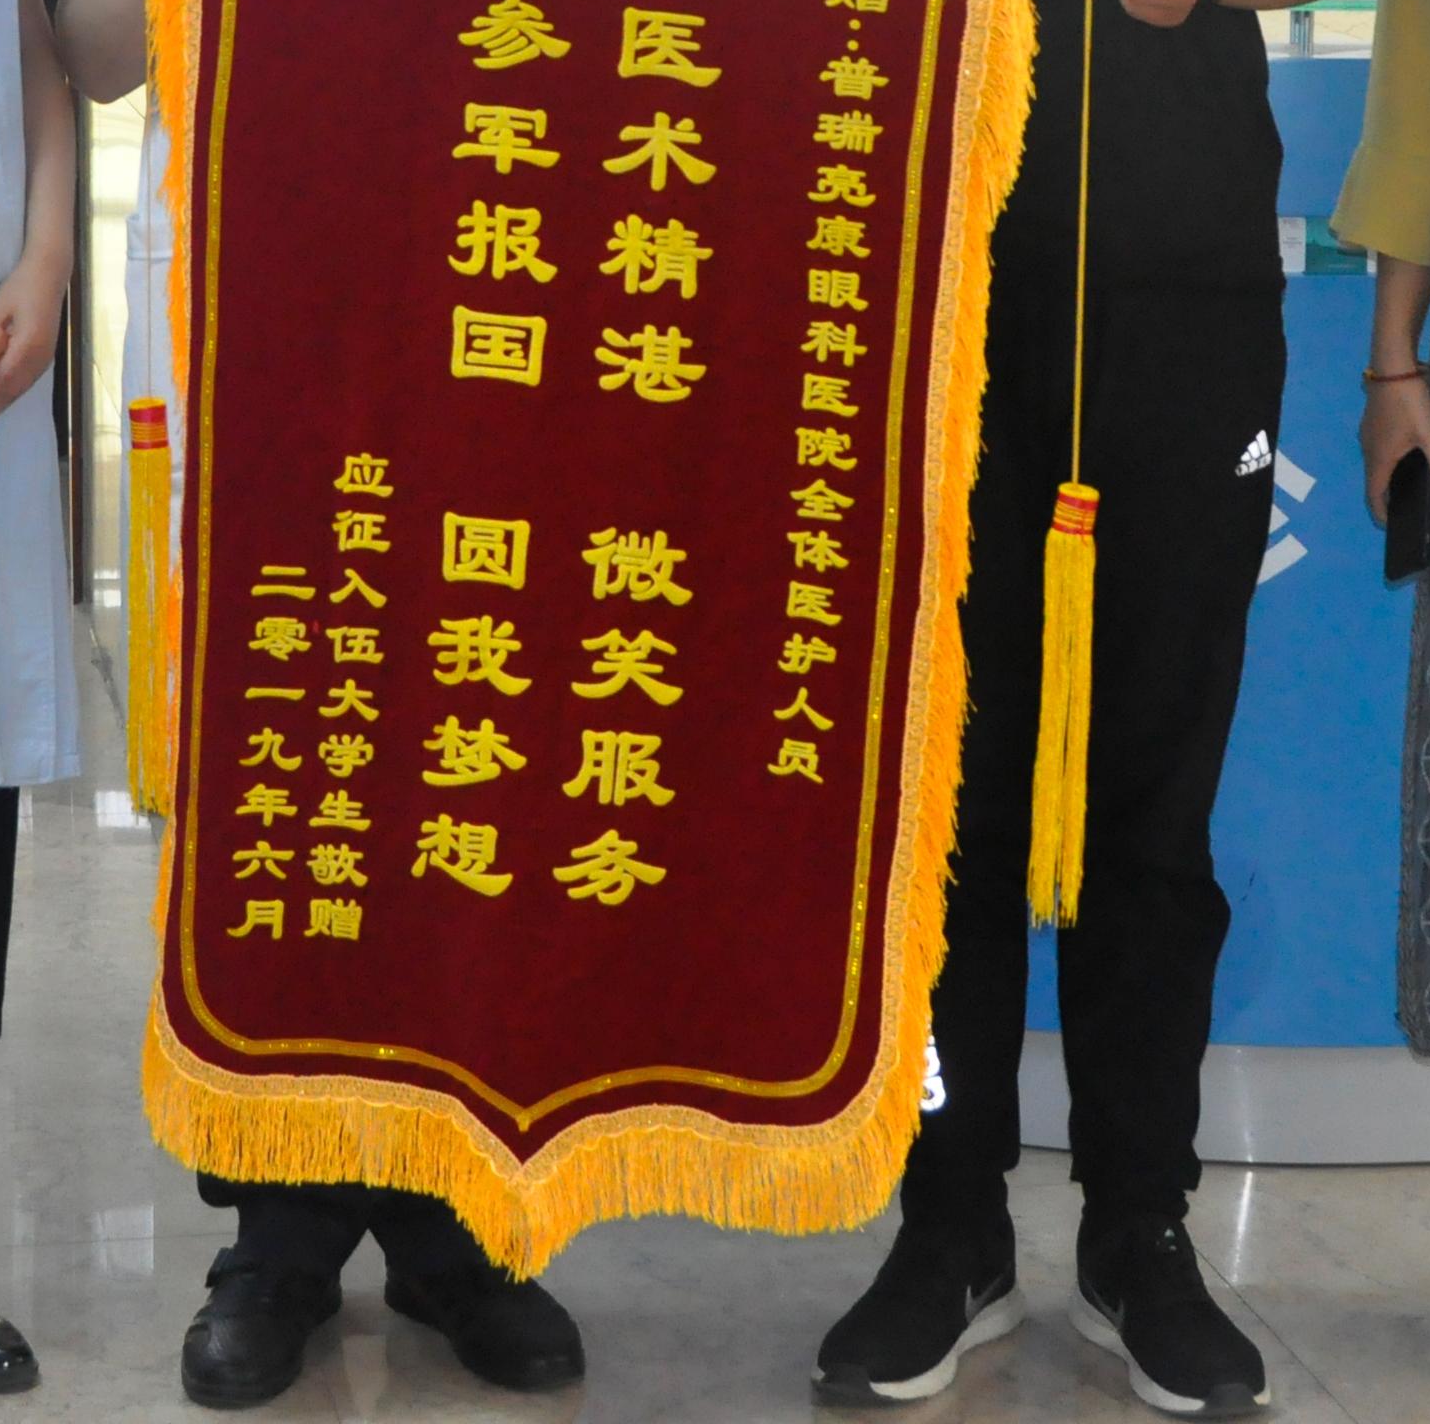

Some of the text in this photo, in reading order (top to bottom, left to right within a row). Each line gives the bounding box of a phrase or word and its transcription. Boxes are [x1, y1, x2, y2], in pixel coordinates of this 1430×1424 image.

[552, 6, 722, 906] 医术精湛 微笑服务
[226, 564, 316, 940] 二零一九年六月
[304, 452, 394, 941] 应征入伍大学生敬赠
[411, 511, 533, 897] 圆我梦想
